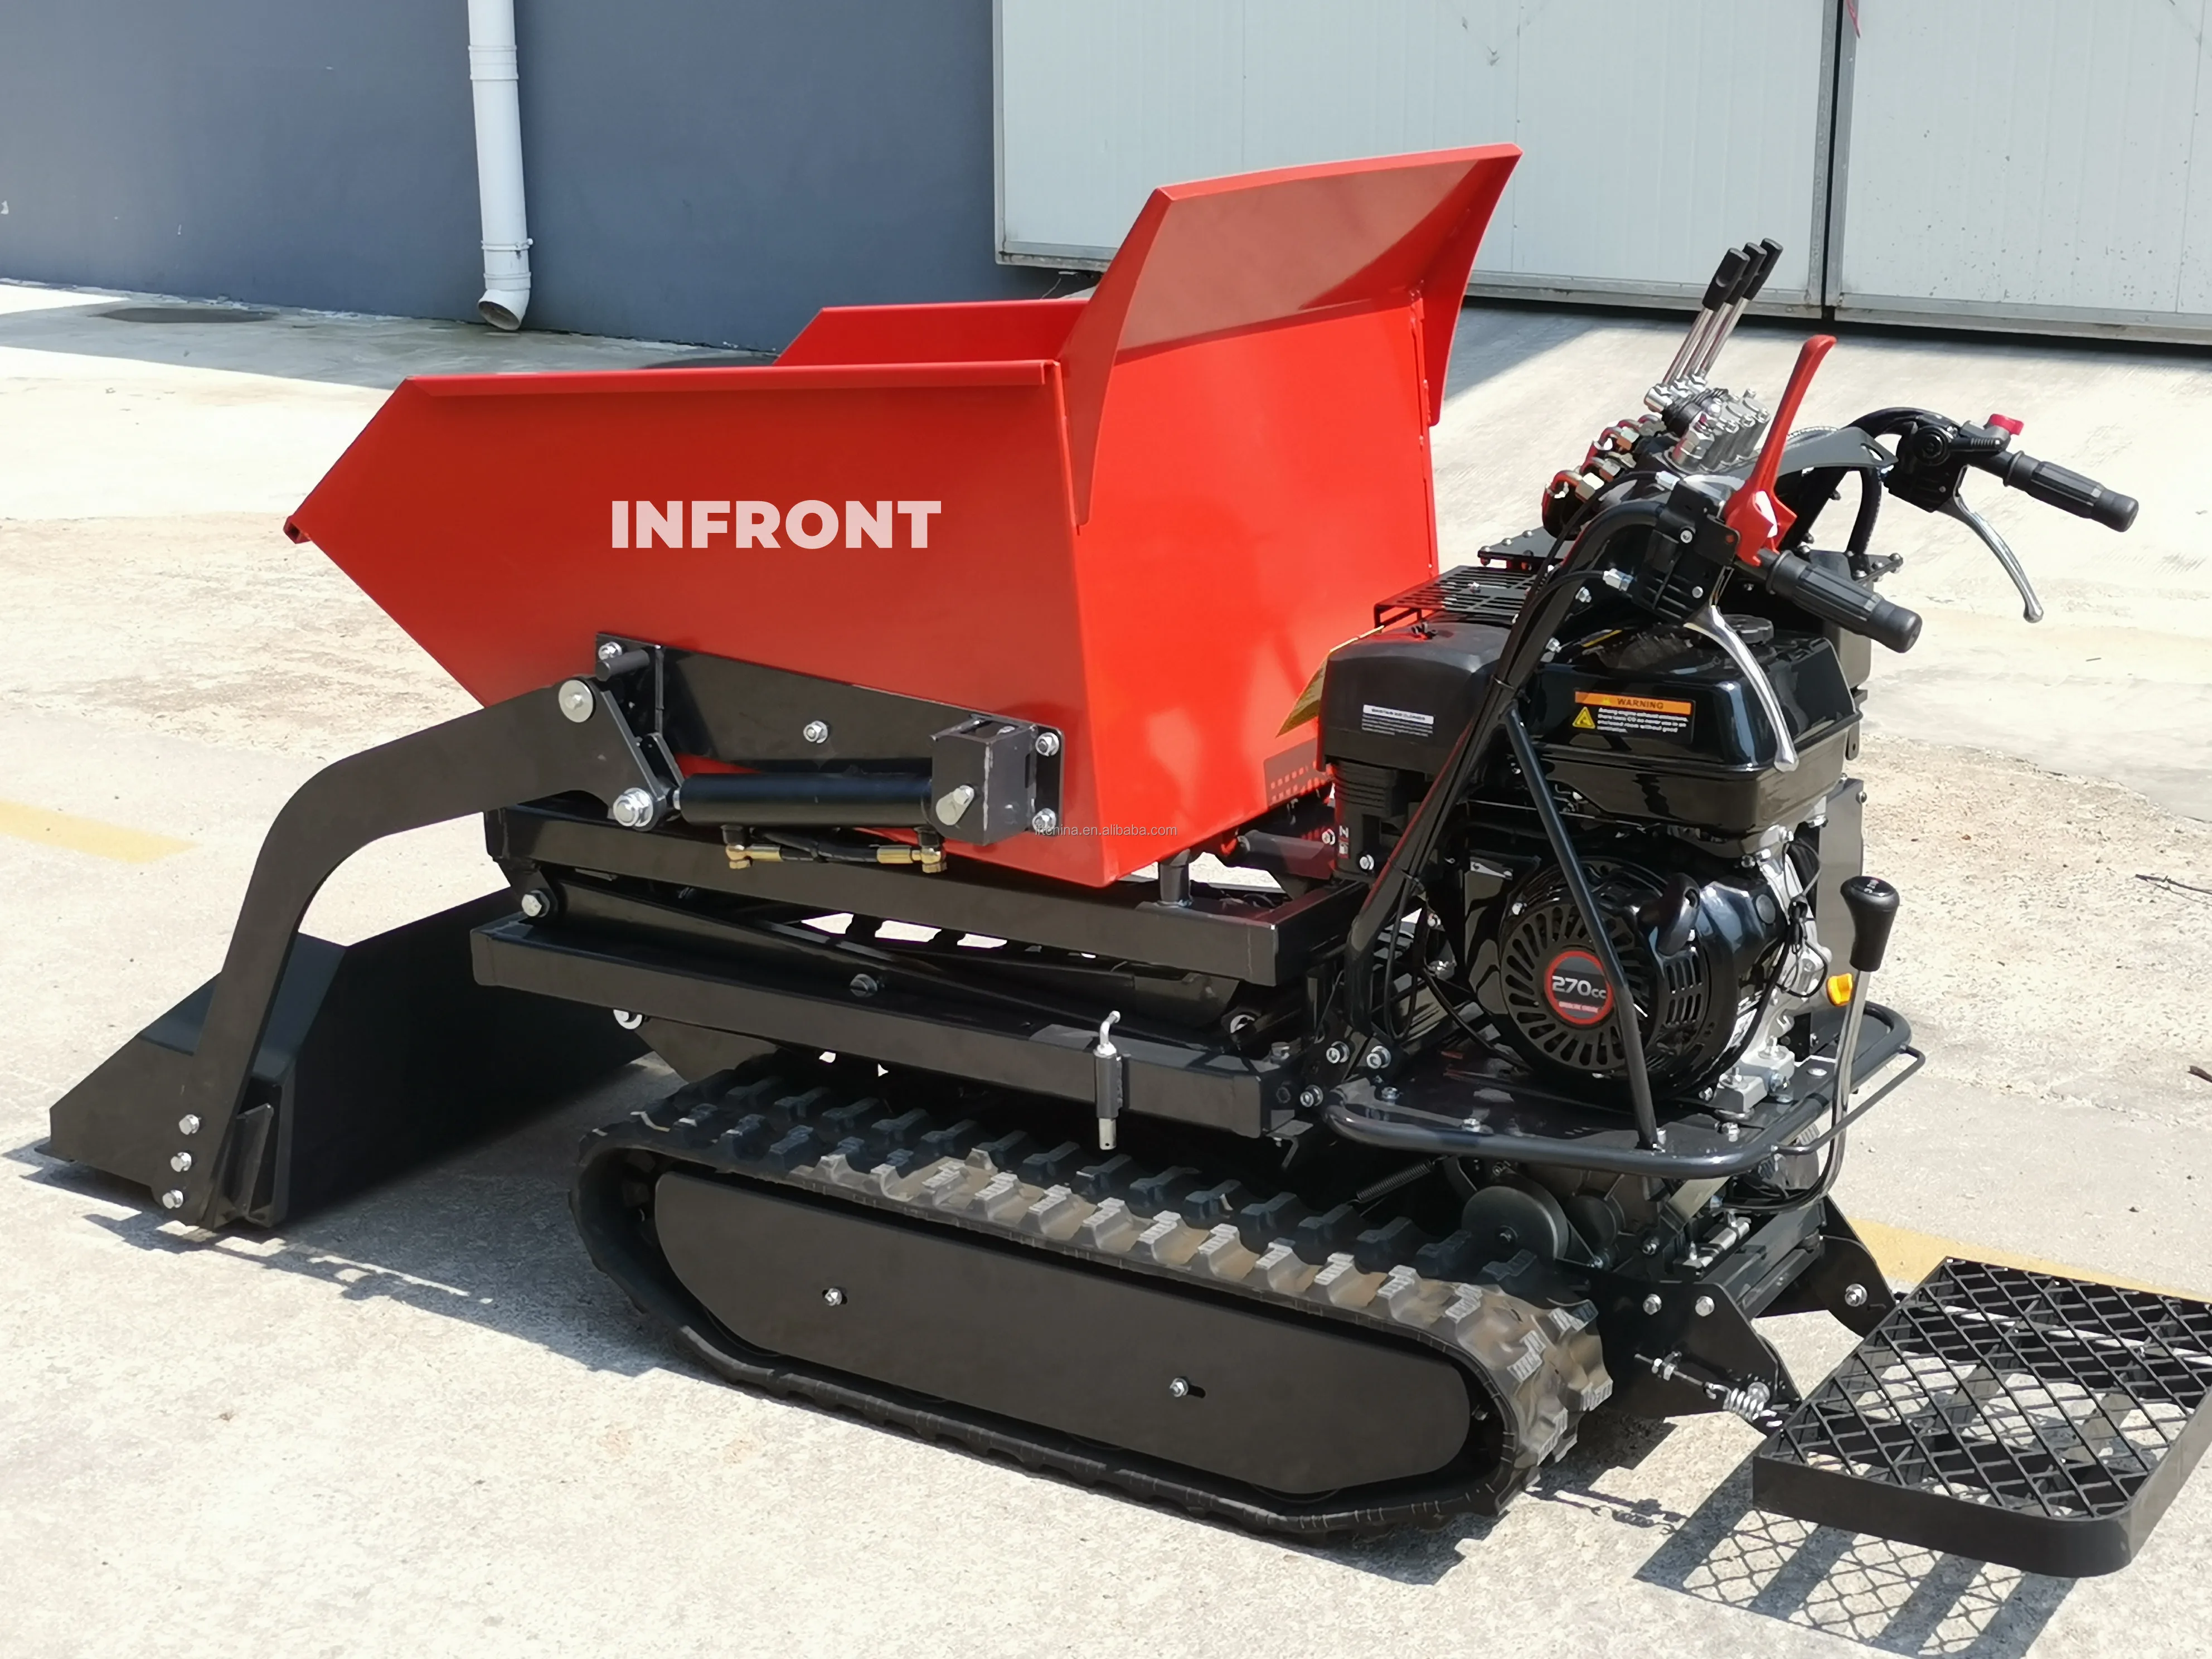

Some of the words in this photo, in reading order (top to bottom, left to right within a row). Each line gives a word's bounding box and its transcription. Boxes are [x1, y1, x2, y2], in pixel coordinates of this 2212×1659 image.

[612, 499, 942, 550] INFRONT
[1617, 698, 1664, 710] WARNING
[1551, 975, 1607, 1000] 270cc
